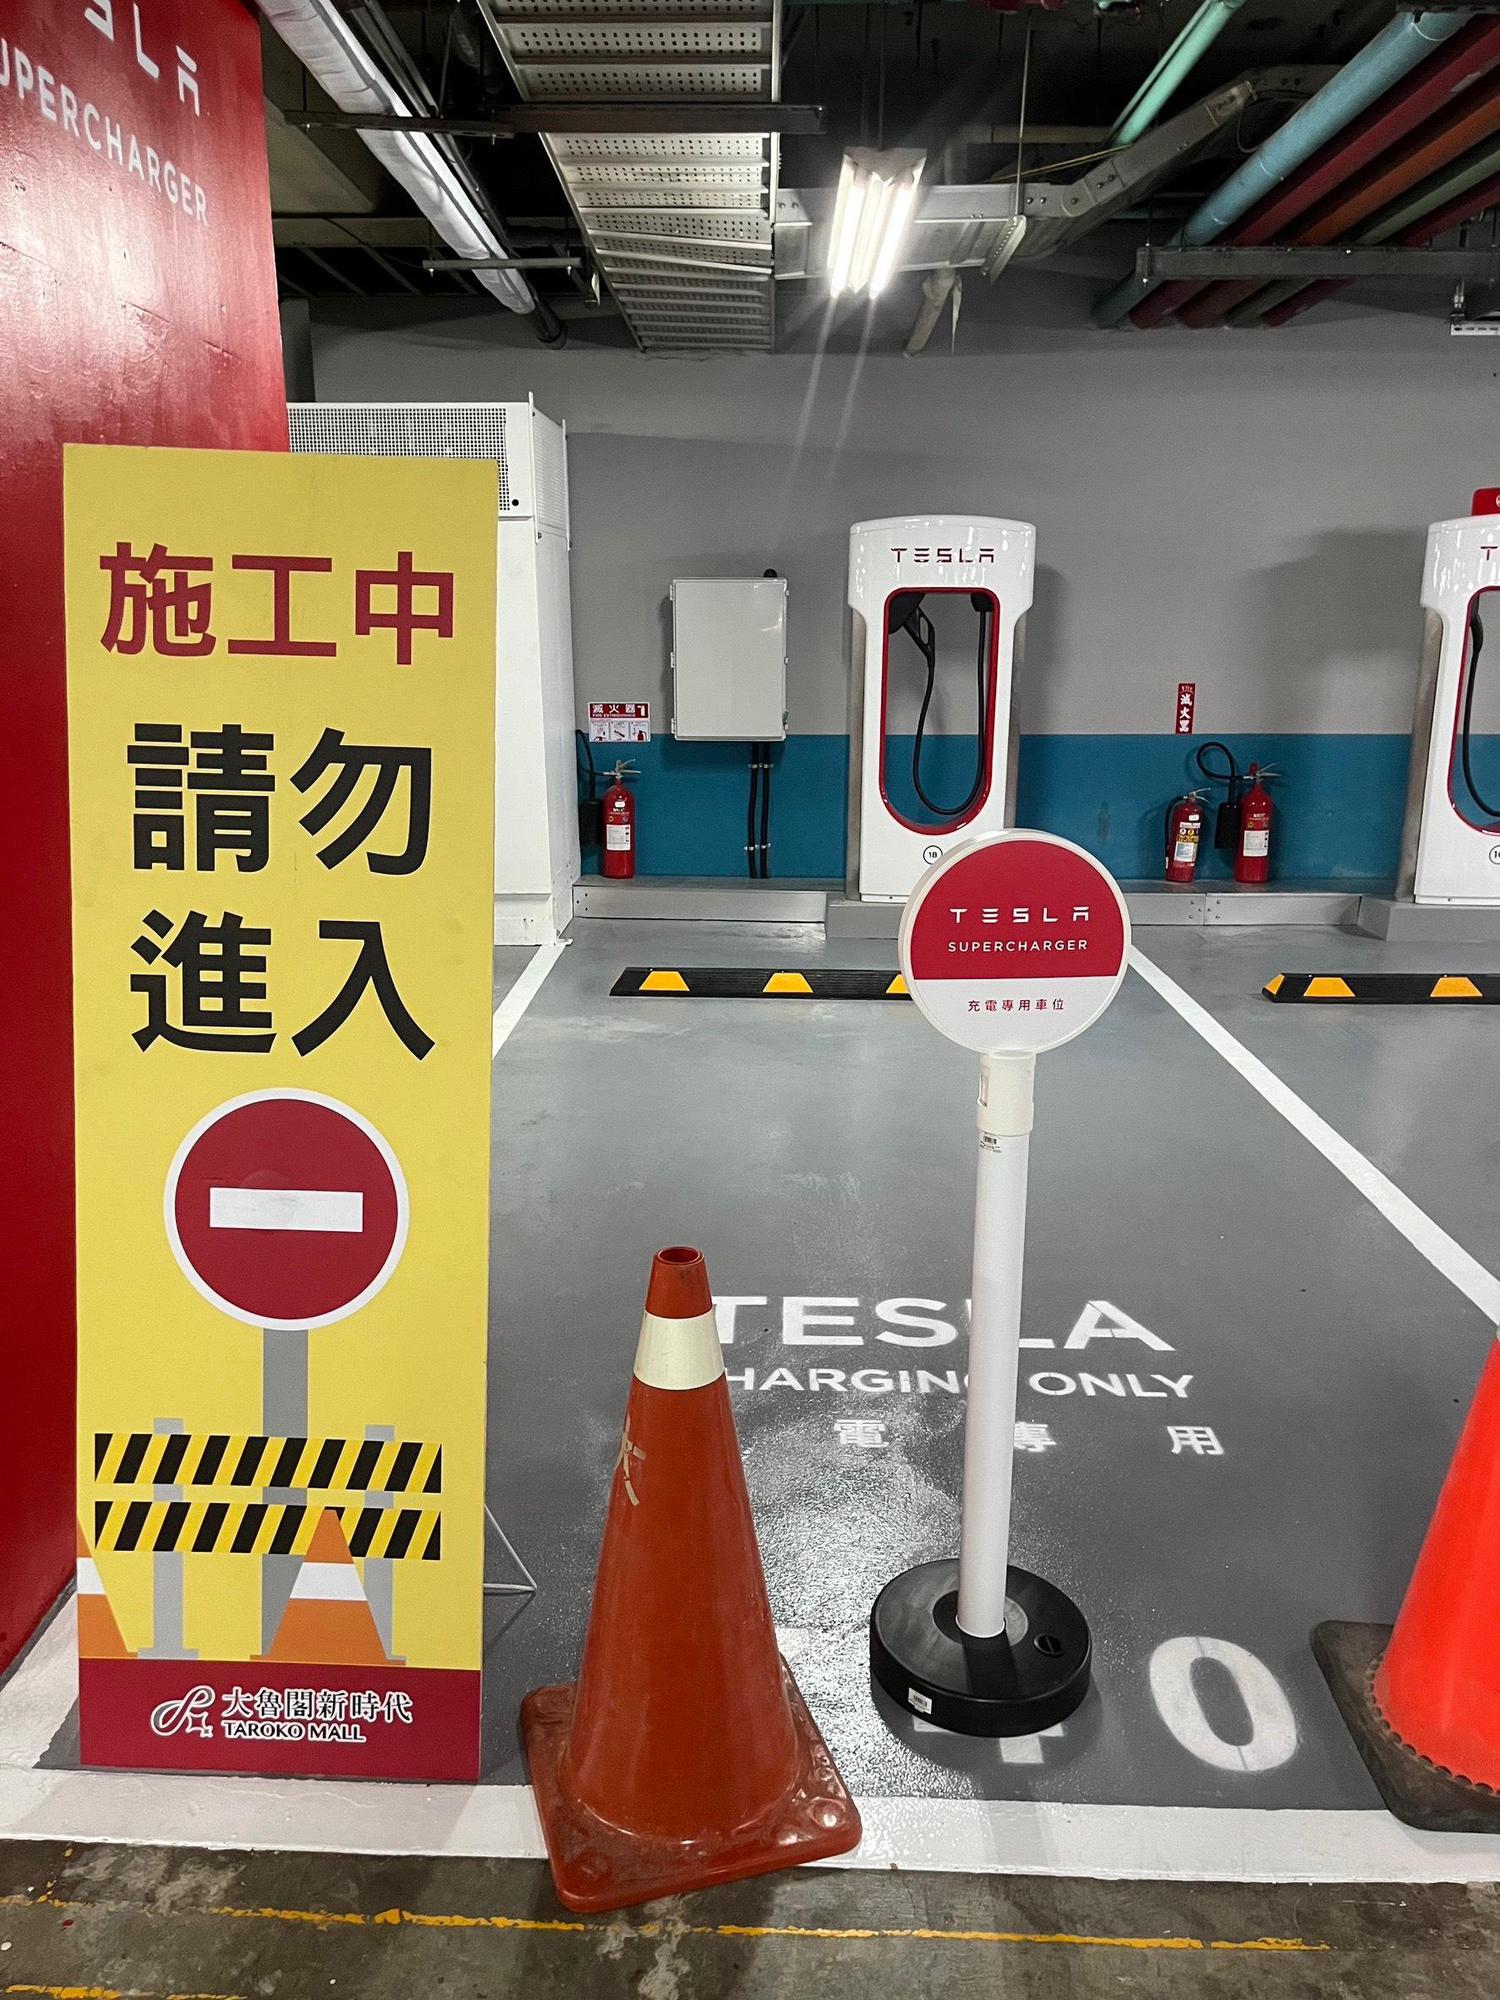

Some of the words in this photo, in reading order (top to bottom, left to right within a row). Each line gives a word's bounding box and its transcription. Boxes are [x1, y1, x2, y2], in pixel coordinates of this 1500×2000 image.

[890, 548, 994, 563] TESLA
[99, 541, 454, 666] 施工中
[127, 722, 432, 876] 請勿
[949, 906, 1090, 924] TESLA
[948, 939, 1088, 952] SUPERCHARGER
[130, 909, 436, 1061] 進入
[967, 998, 1065, 1012] 充電專用車位
[726, 1367, 969, 1394] HARGIN
[1029, 1371, 1194, 1399] ONLY
[222, 1686, 412, 1724] 大魯閣新時代
[223, 1721, 303, 1740] TAROKO
[308, 1723, 367, 1743] MALL
